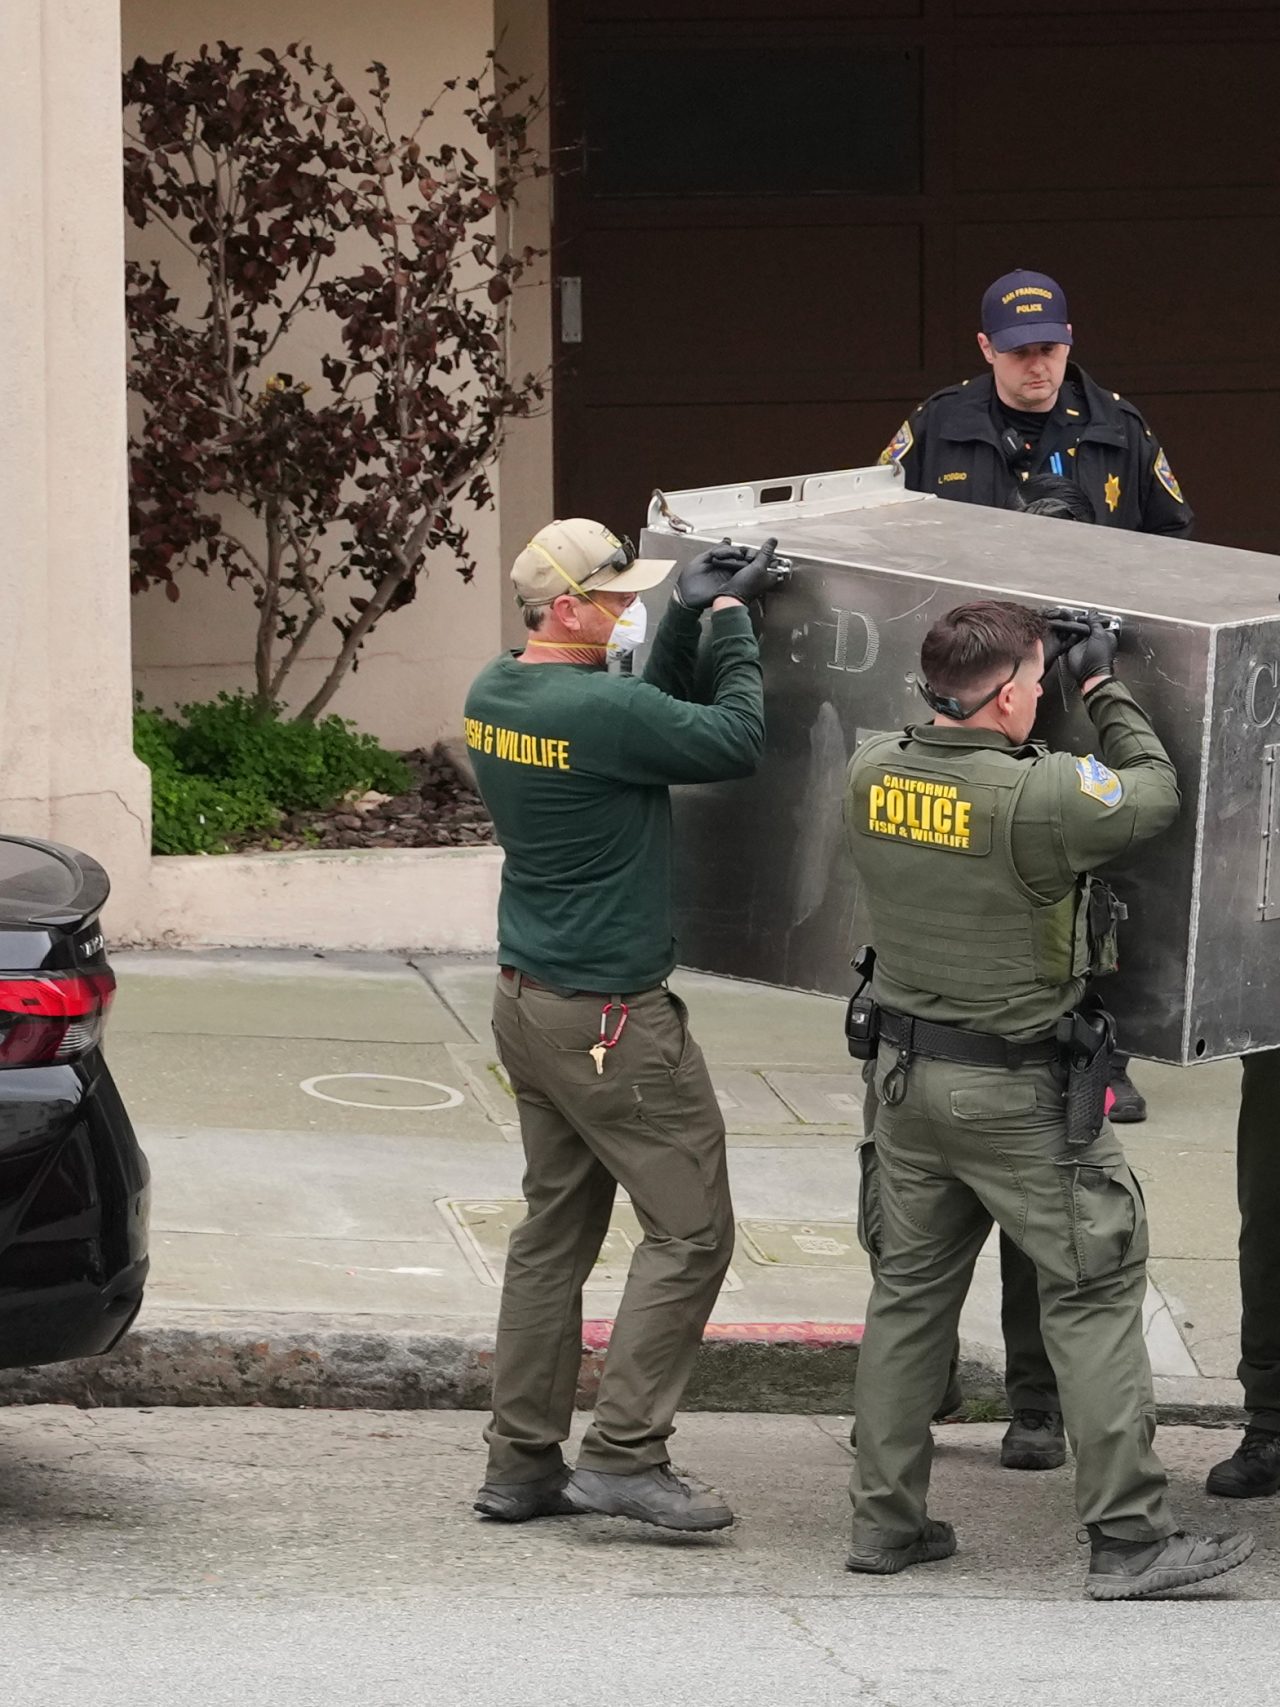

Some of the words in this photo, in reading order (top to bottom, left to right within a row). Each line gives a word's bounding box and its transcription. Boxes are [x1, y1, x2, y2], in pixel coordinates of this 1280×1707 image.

[1001, 291, 1015, 305] SAN
[1015, 286, 1053, 300] FRANCISCO
[1016, 303, 1043, 314] POLICE
[484, 724, 493, 754] &
[496, 727, 571, 770] WILDLIFE
[883, 774, 957, 799] CALIFORNIA
[869, 784, 971, 837] POLICE
[869, 818, 896, 835] FISH
[898, 826, 908, 838] &
[910, 827, 970, 849] WILDLIFE
